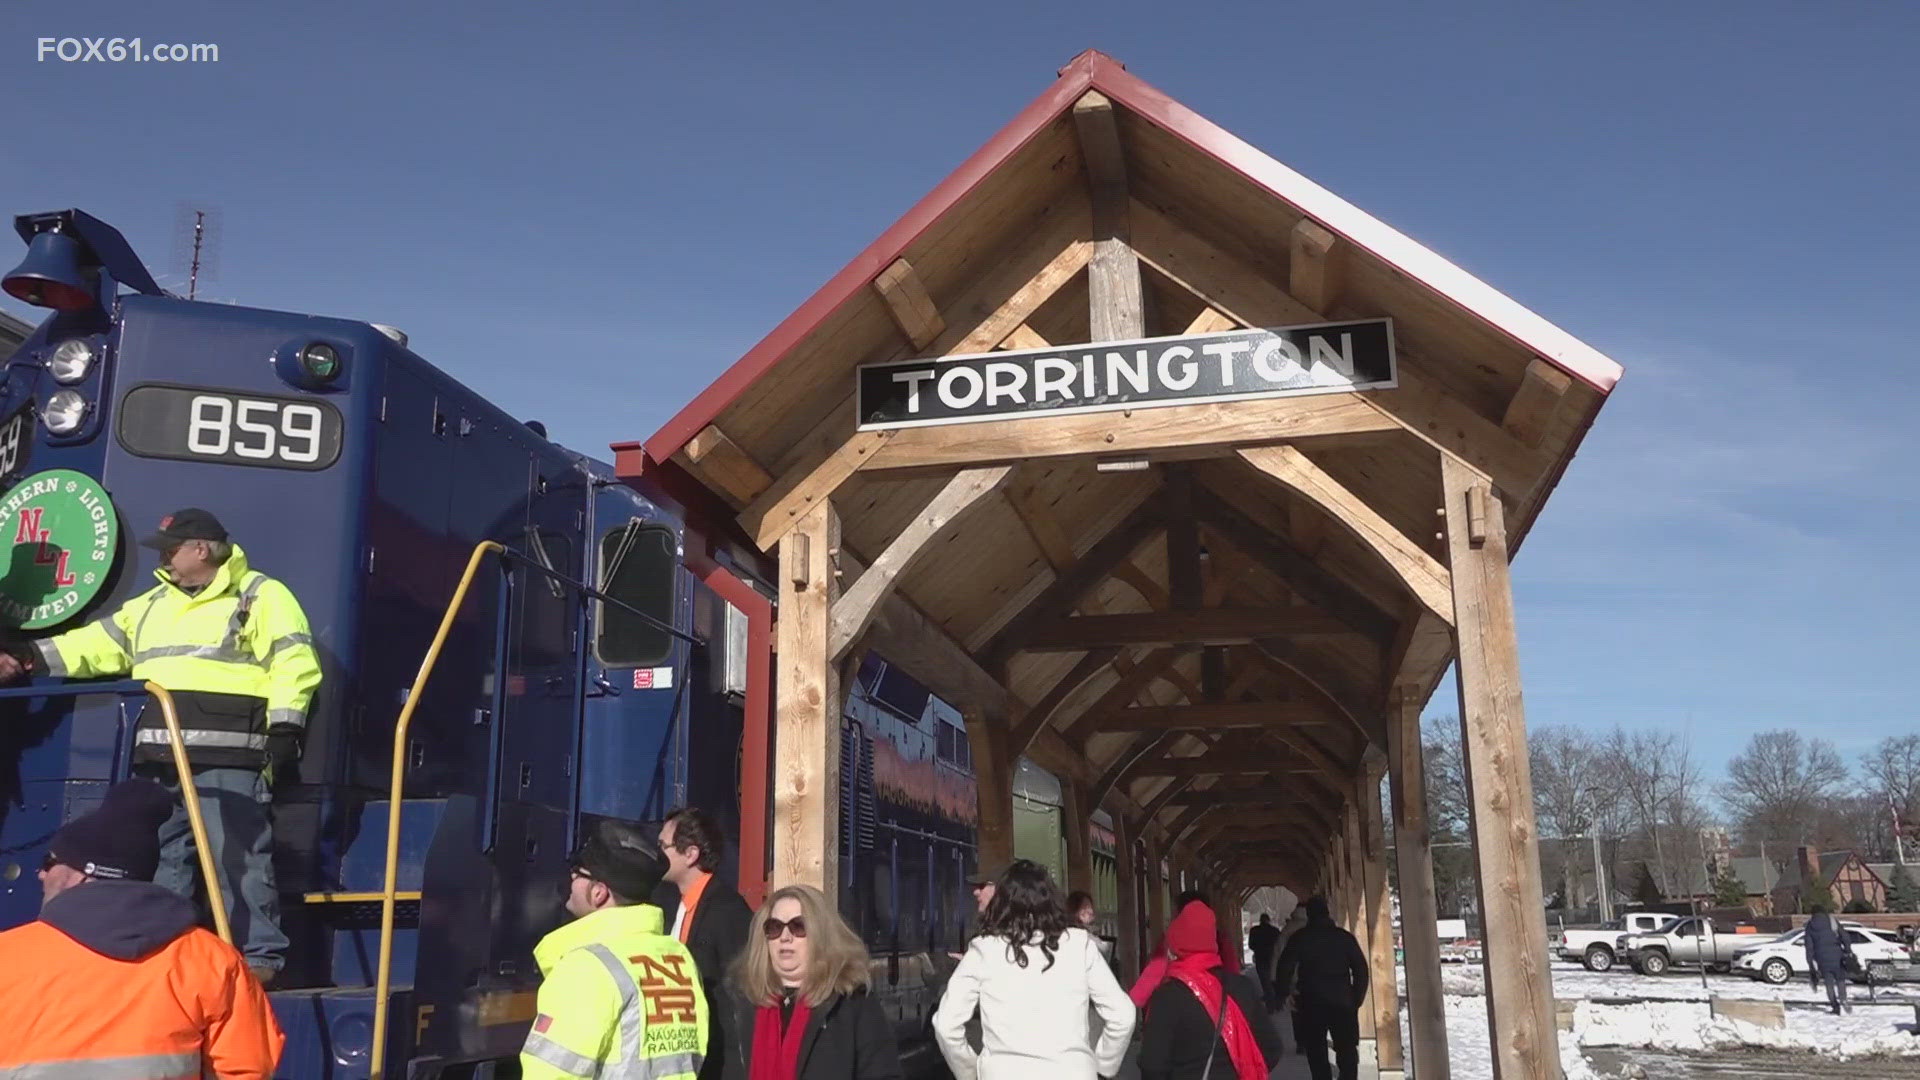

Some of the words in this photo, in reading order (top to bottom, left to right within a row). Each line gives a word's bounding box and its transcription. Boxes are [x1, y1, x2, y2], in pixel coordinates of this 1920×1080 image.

[892, 332, 1353, 414] TORRINGTON
[188, 396, 322, 462] 859
[0, 478, 59, 533] THERN
[78, 488, 109, 561] LIGHTS
